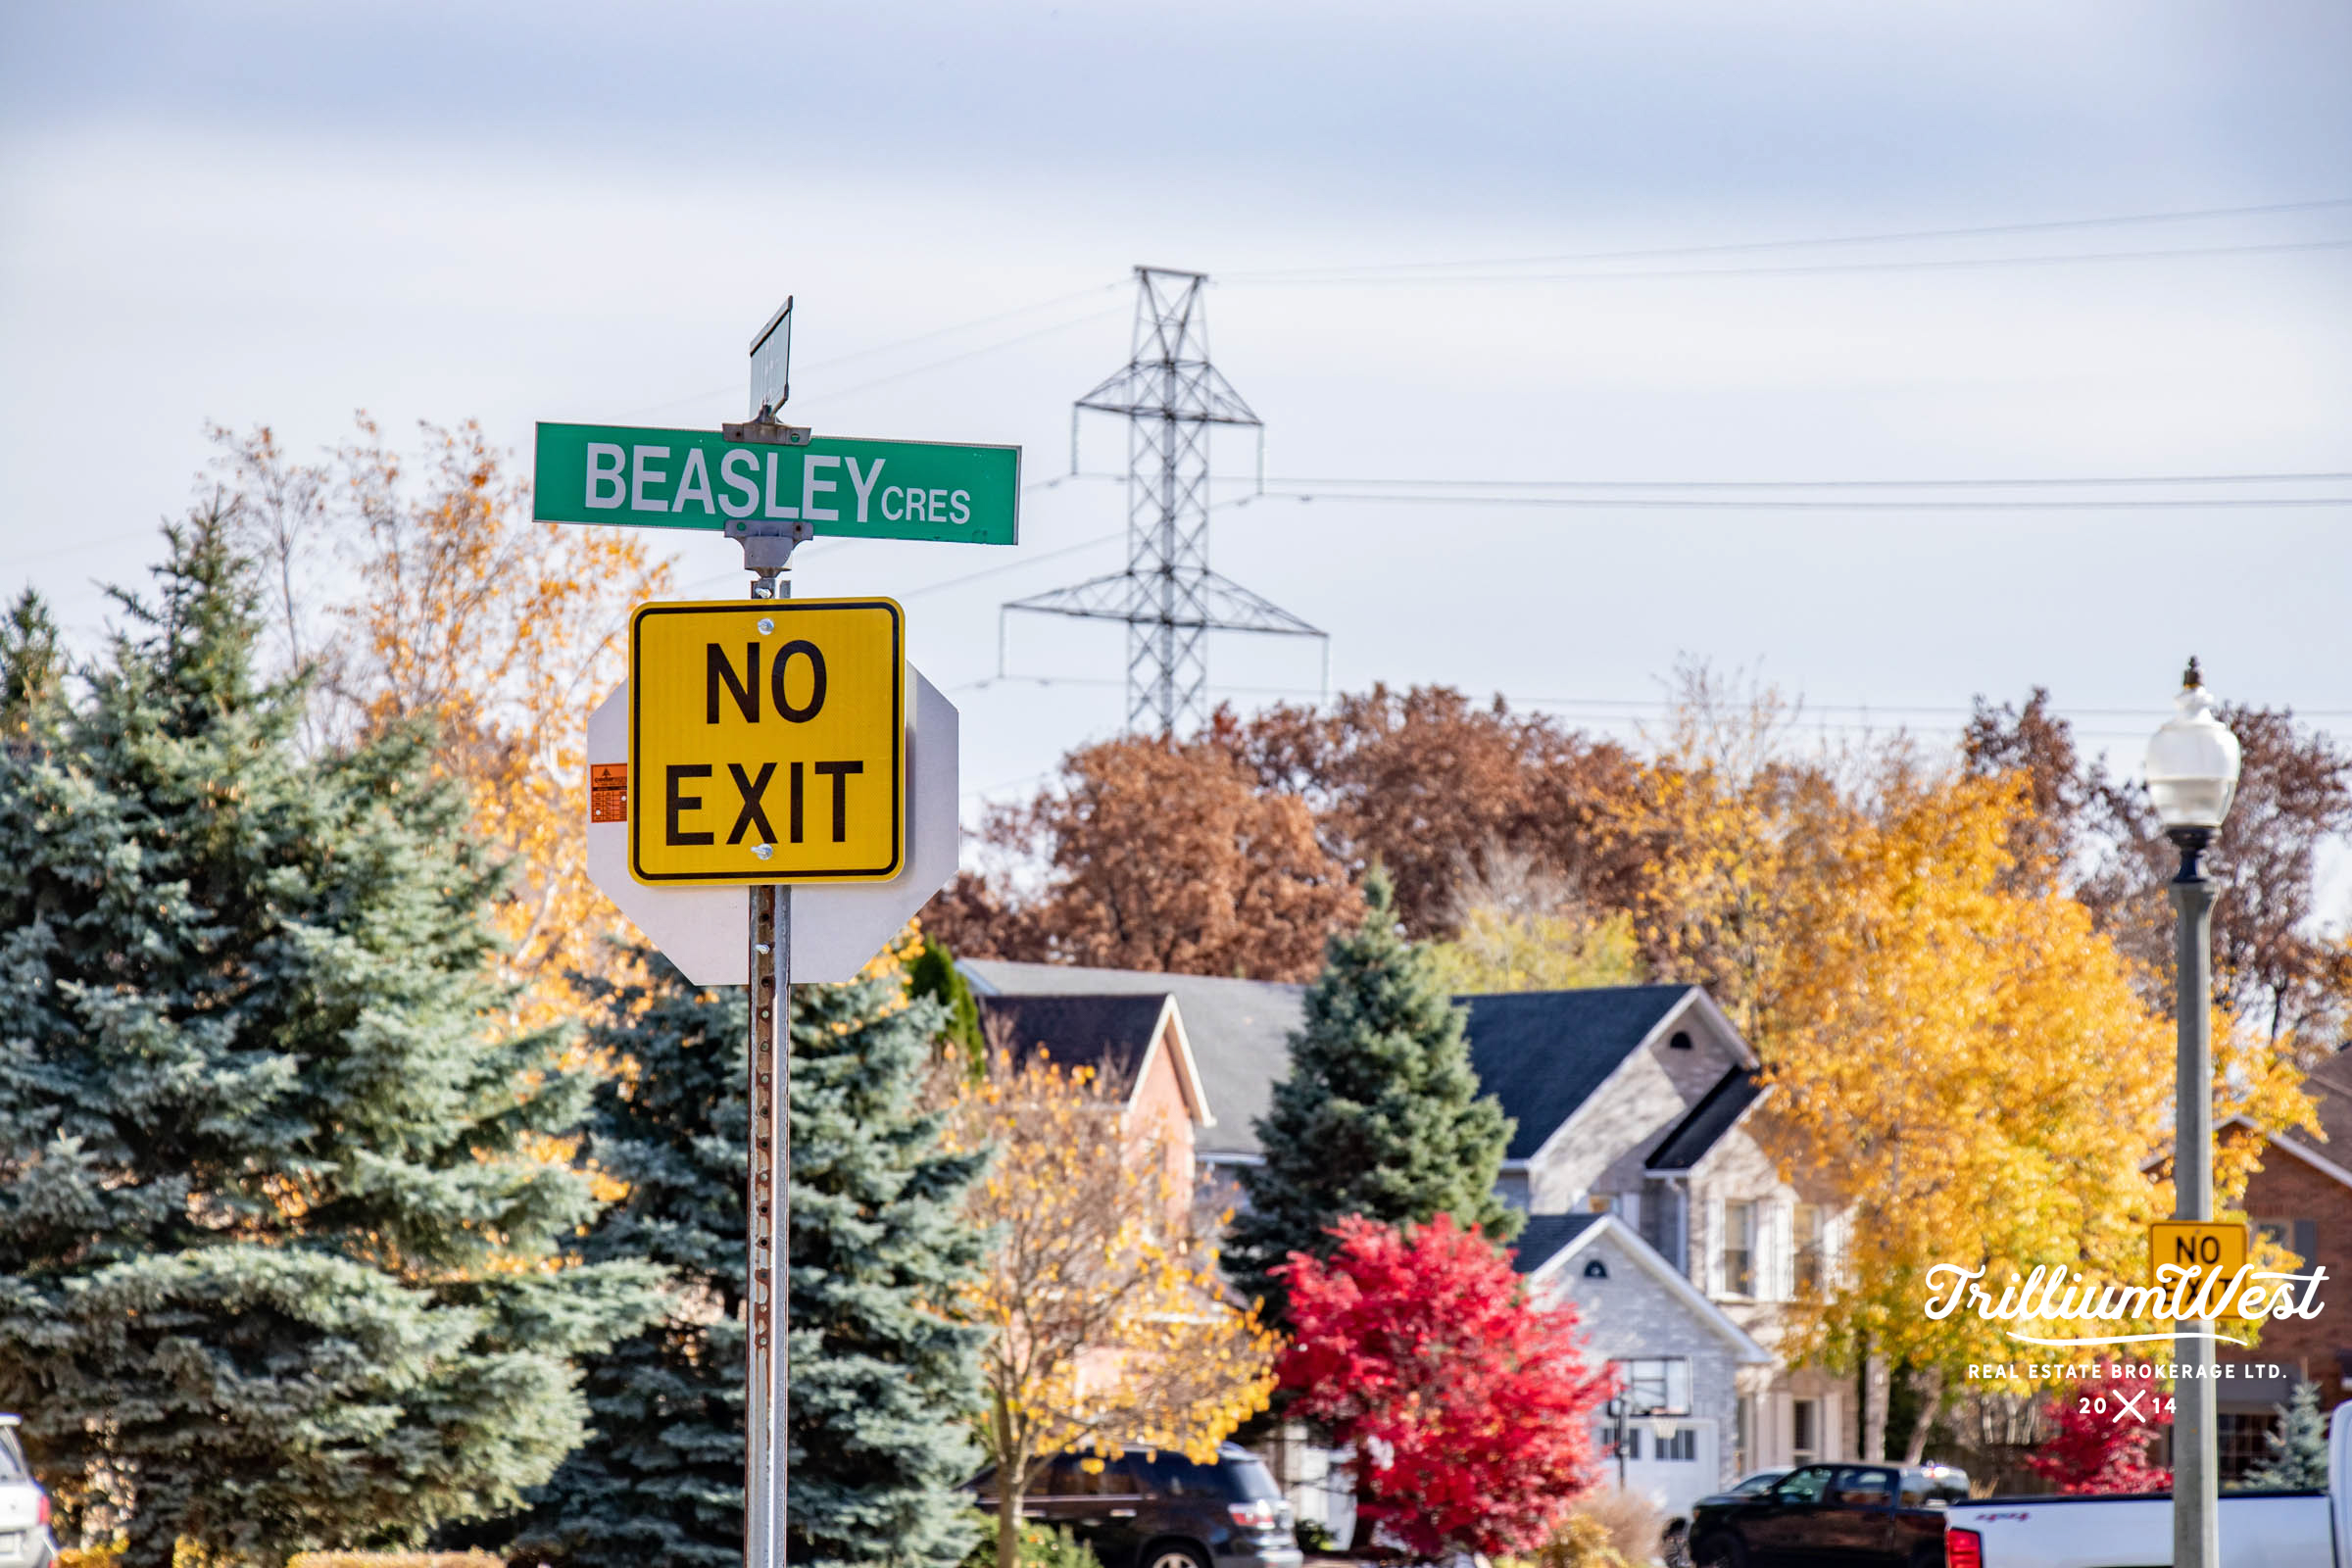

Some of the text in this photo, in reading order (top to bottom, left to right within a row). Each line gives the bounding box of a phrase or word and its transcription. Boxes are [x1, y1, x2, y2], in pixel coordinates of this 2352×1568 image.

[585, 442, 971, 524] BEASLEY CRES
[707, 639, 827, 724] NO
[665, 760, 864, 846] EXIT
[2176, 1236, 2221, 1264] NO
